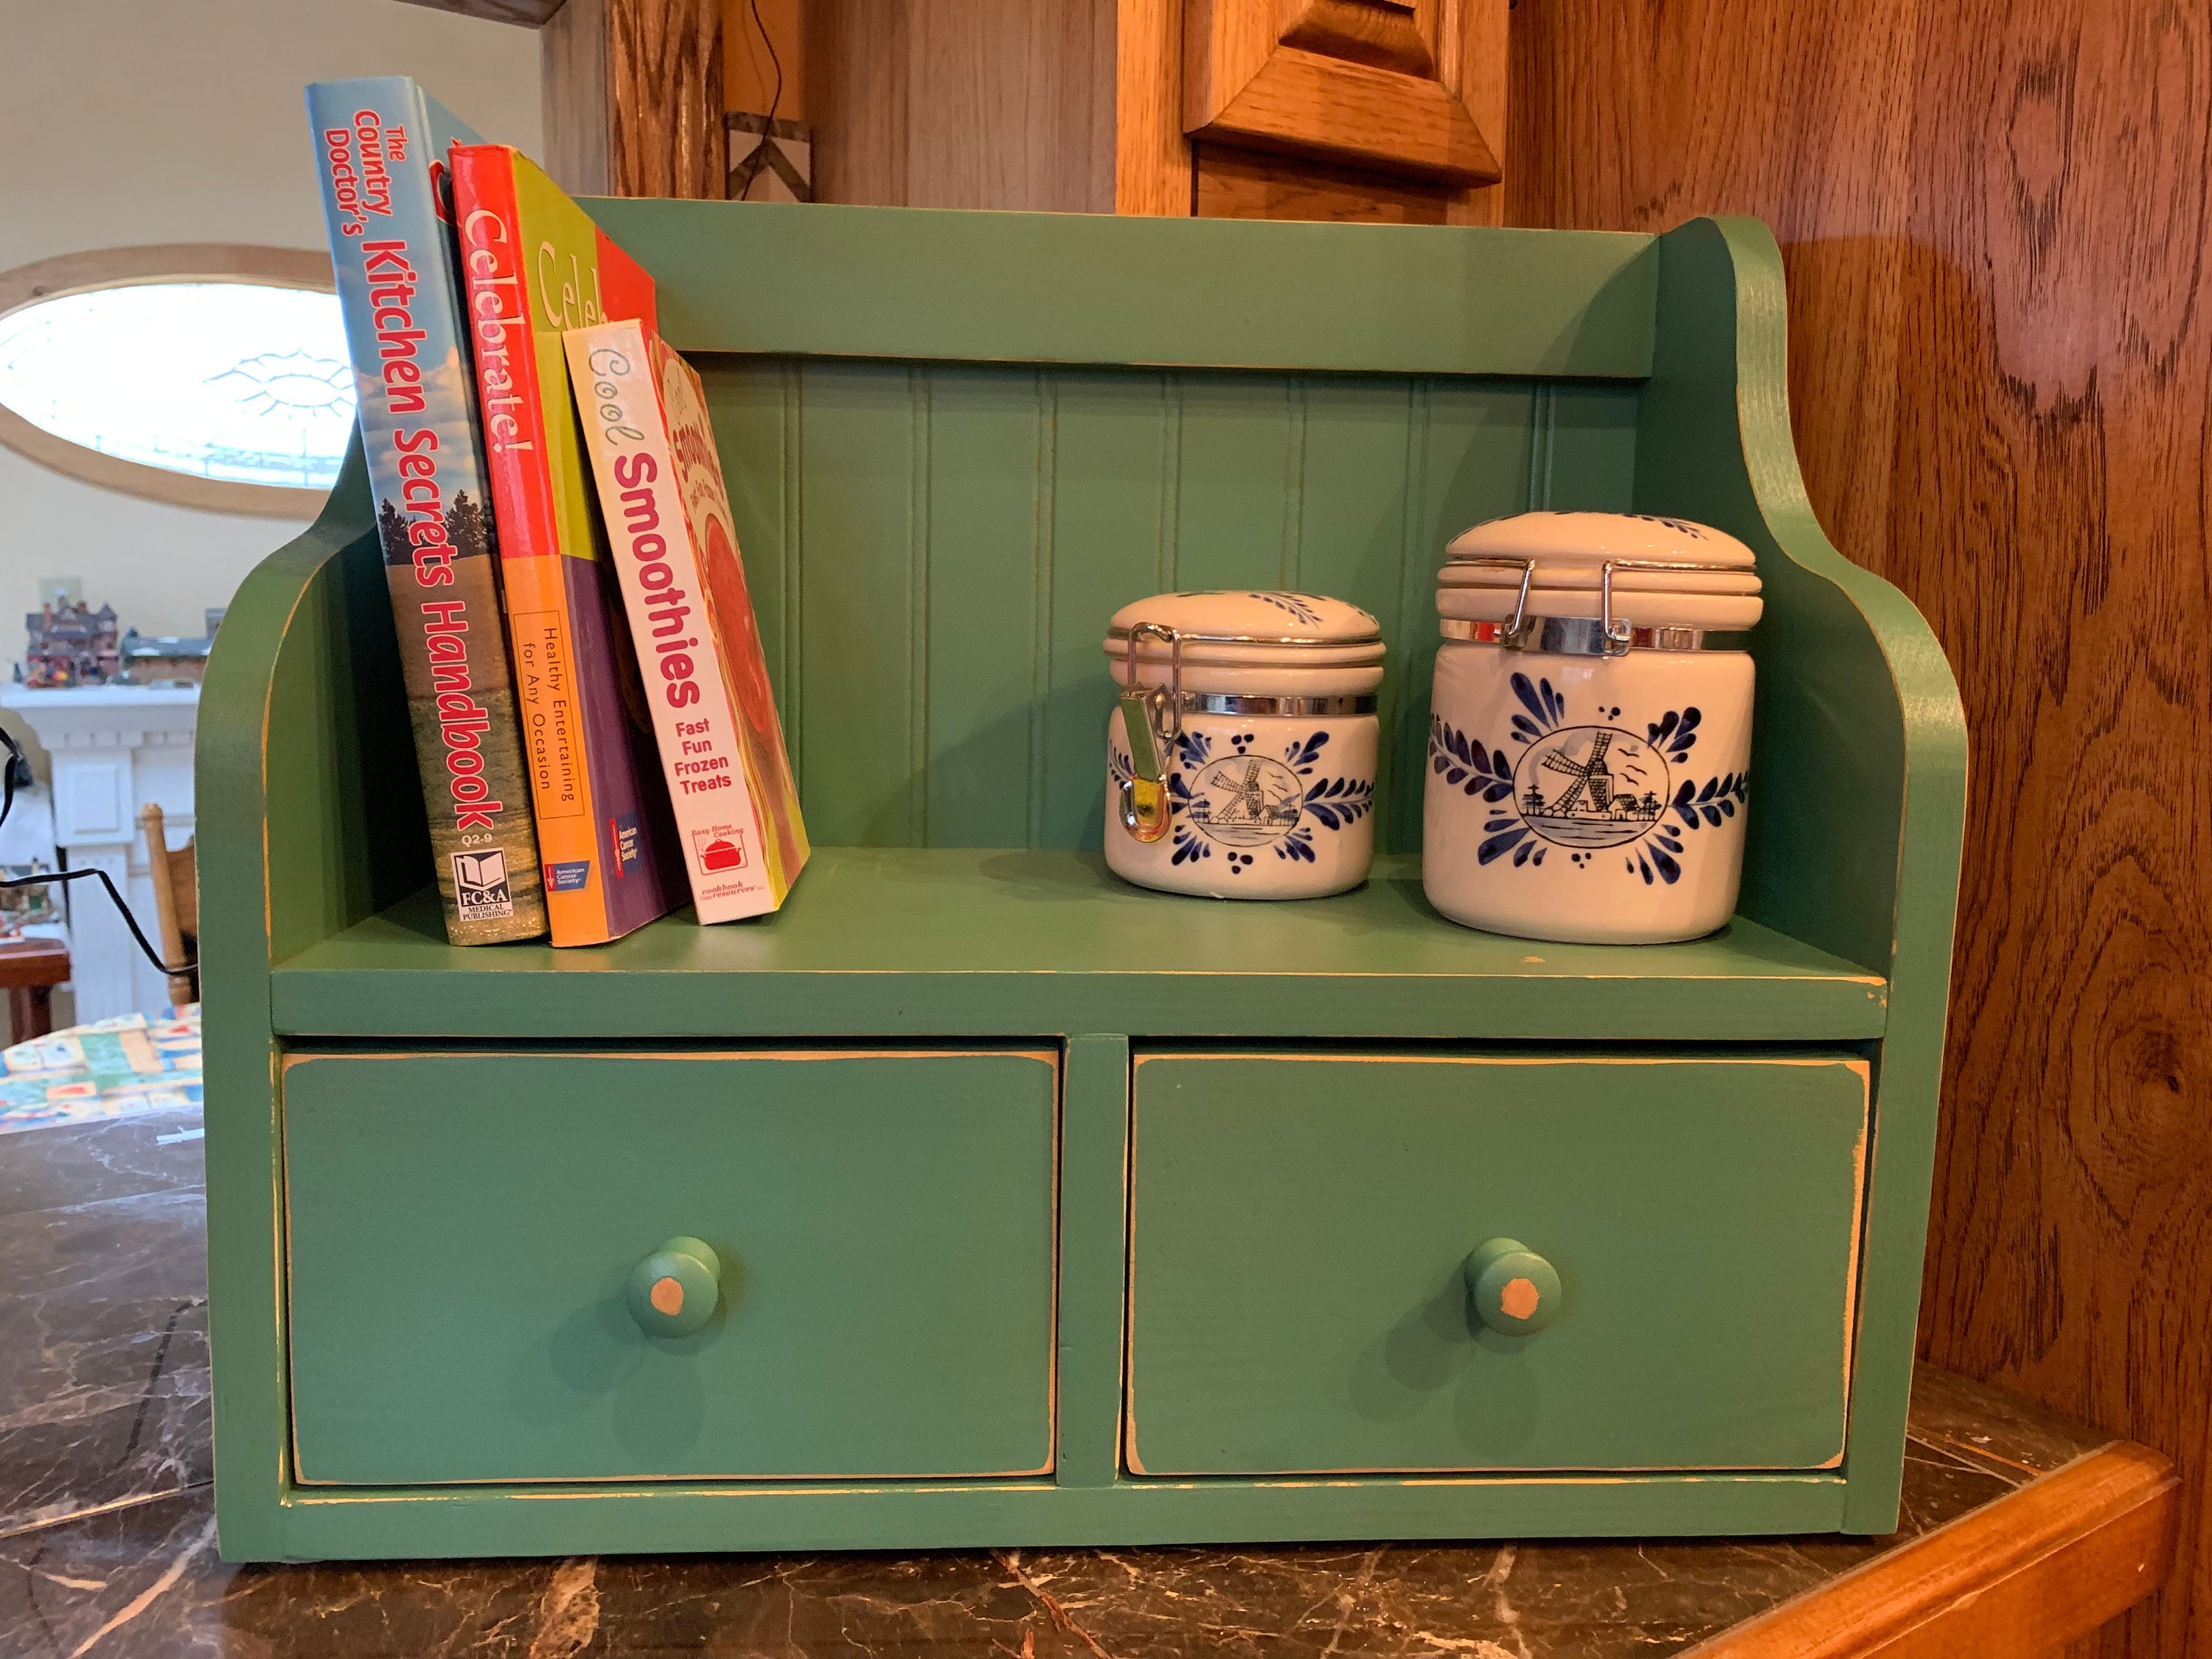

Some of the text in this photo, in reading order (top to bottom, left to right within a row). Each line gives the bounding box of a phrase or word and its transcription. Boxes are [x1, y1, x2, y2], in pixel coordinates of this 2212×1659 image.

[383, 124, 409, 162] The
[353, 109, 393, 217] Country
[324, 128, 369, 237] Doctor's
[538, 241, 611, 331] Celeb
[465, 209, 534, 454] Celebrate!
[361, 240, 504, 831] Kitchen Secrets Handbook
[588, 348, 700, 709] Cool Smoothies
[523, 642, 550, 790] for Any Occasion
[543, 627, 575, 801] Healthy Entertaining
[675, 718, 709, 737] Fast
[682, 740, 712, 756] Fun
[674, 757, 728, 777] Frozen
[680, 774, 731, 795] Treats
[712, 824, 732, 832] Home
[714, 828, 744, 838] Cooking
[461, 833, 493, 847] Q2-9
[556, 867, 585, 875] American
[462, 888, 508, 906] FC&A
[702, 880, 743, 895] cookbook
[463, 909, 512, 920] PUBLISHING
[468, 903, 505, 914] MEDICAL
